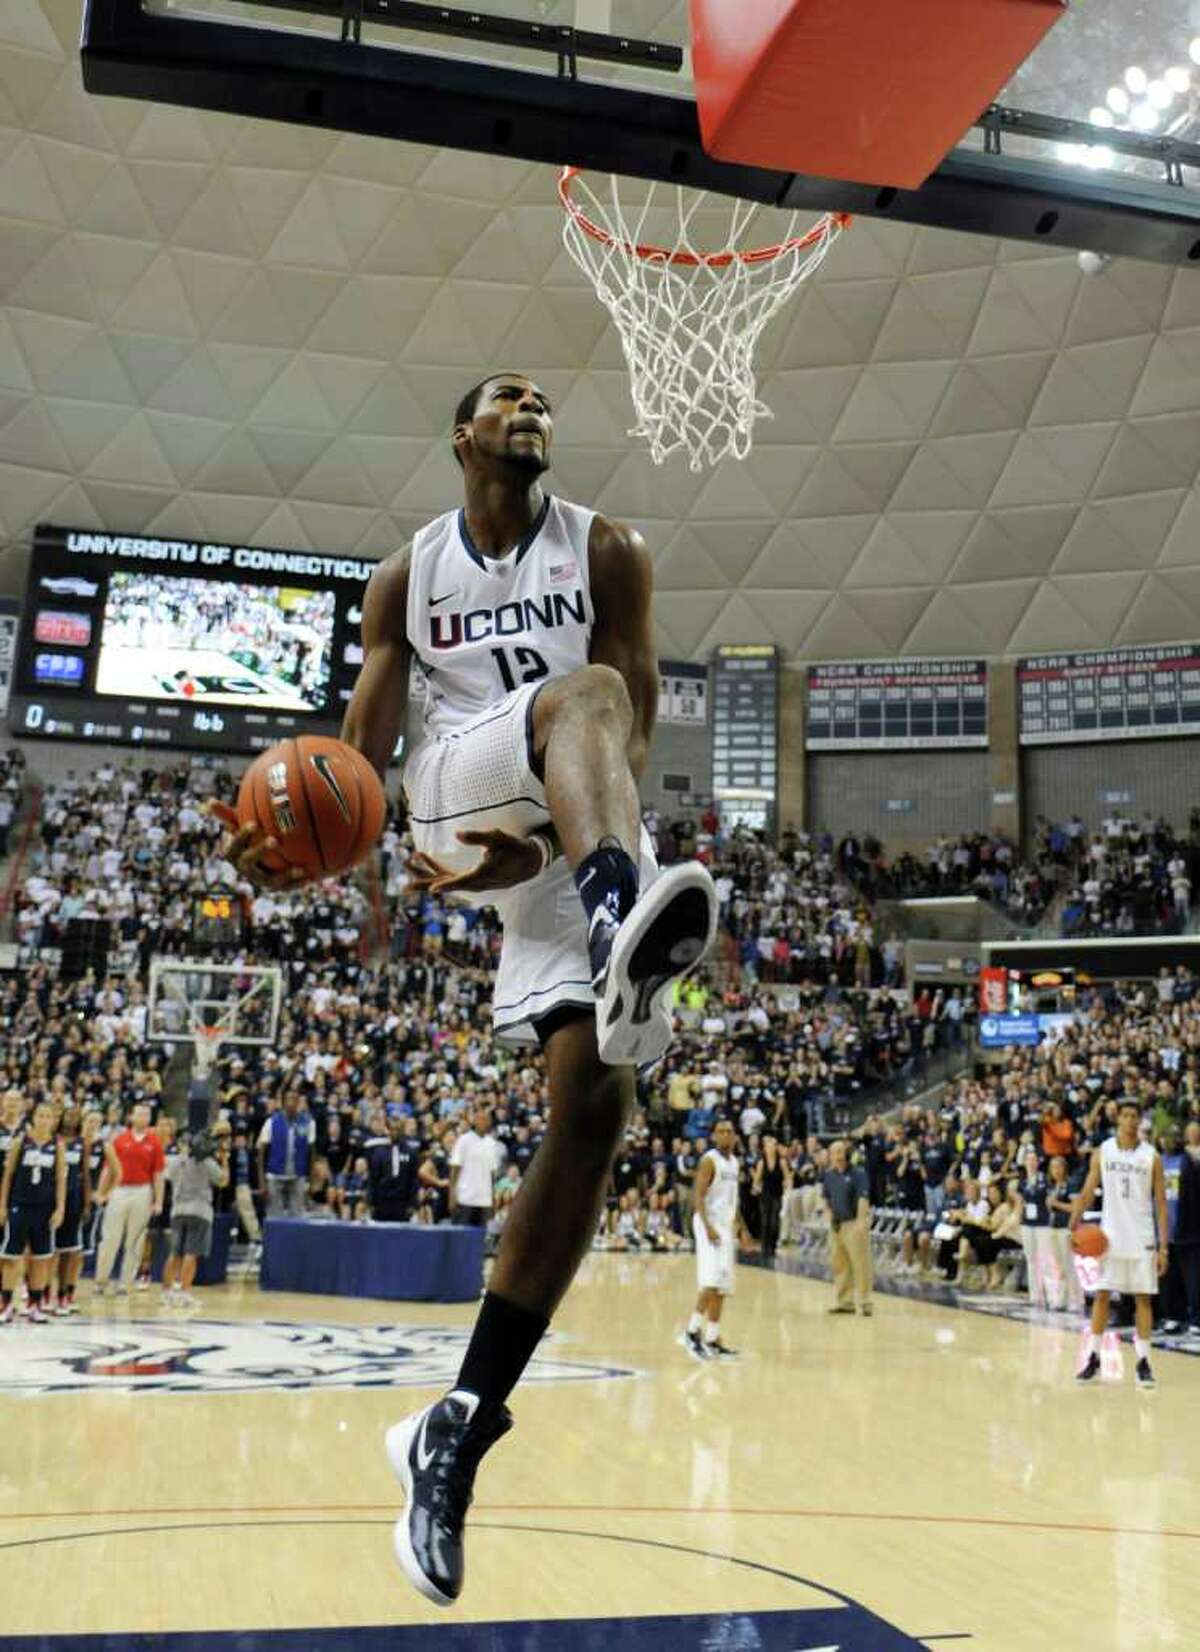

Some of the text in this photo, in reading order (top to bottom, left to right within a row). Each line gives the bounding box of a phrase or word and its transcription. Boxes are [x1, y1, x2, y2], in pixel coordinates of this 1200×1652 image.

[67, 533, 197, 562] UNIVERSITY
[201, 544, 231, 565] OF
[430, 590, 586, 649] UCONN
[864, 663, 977, 676] CHAMPIONSHIP
[1074, 648, 1193, 666] CHAMPIONSHIP
